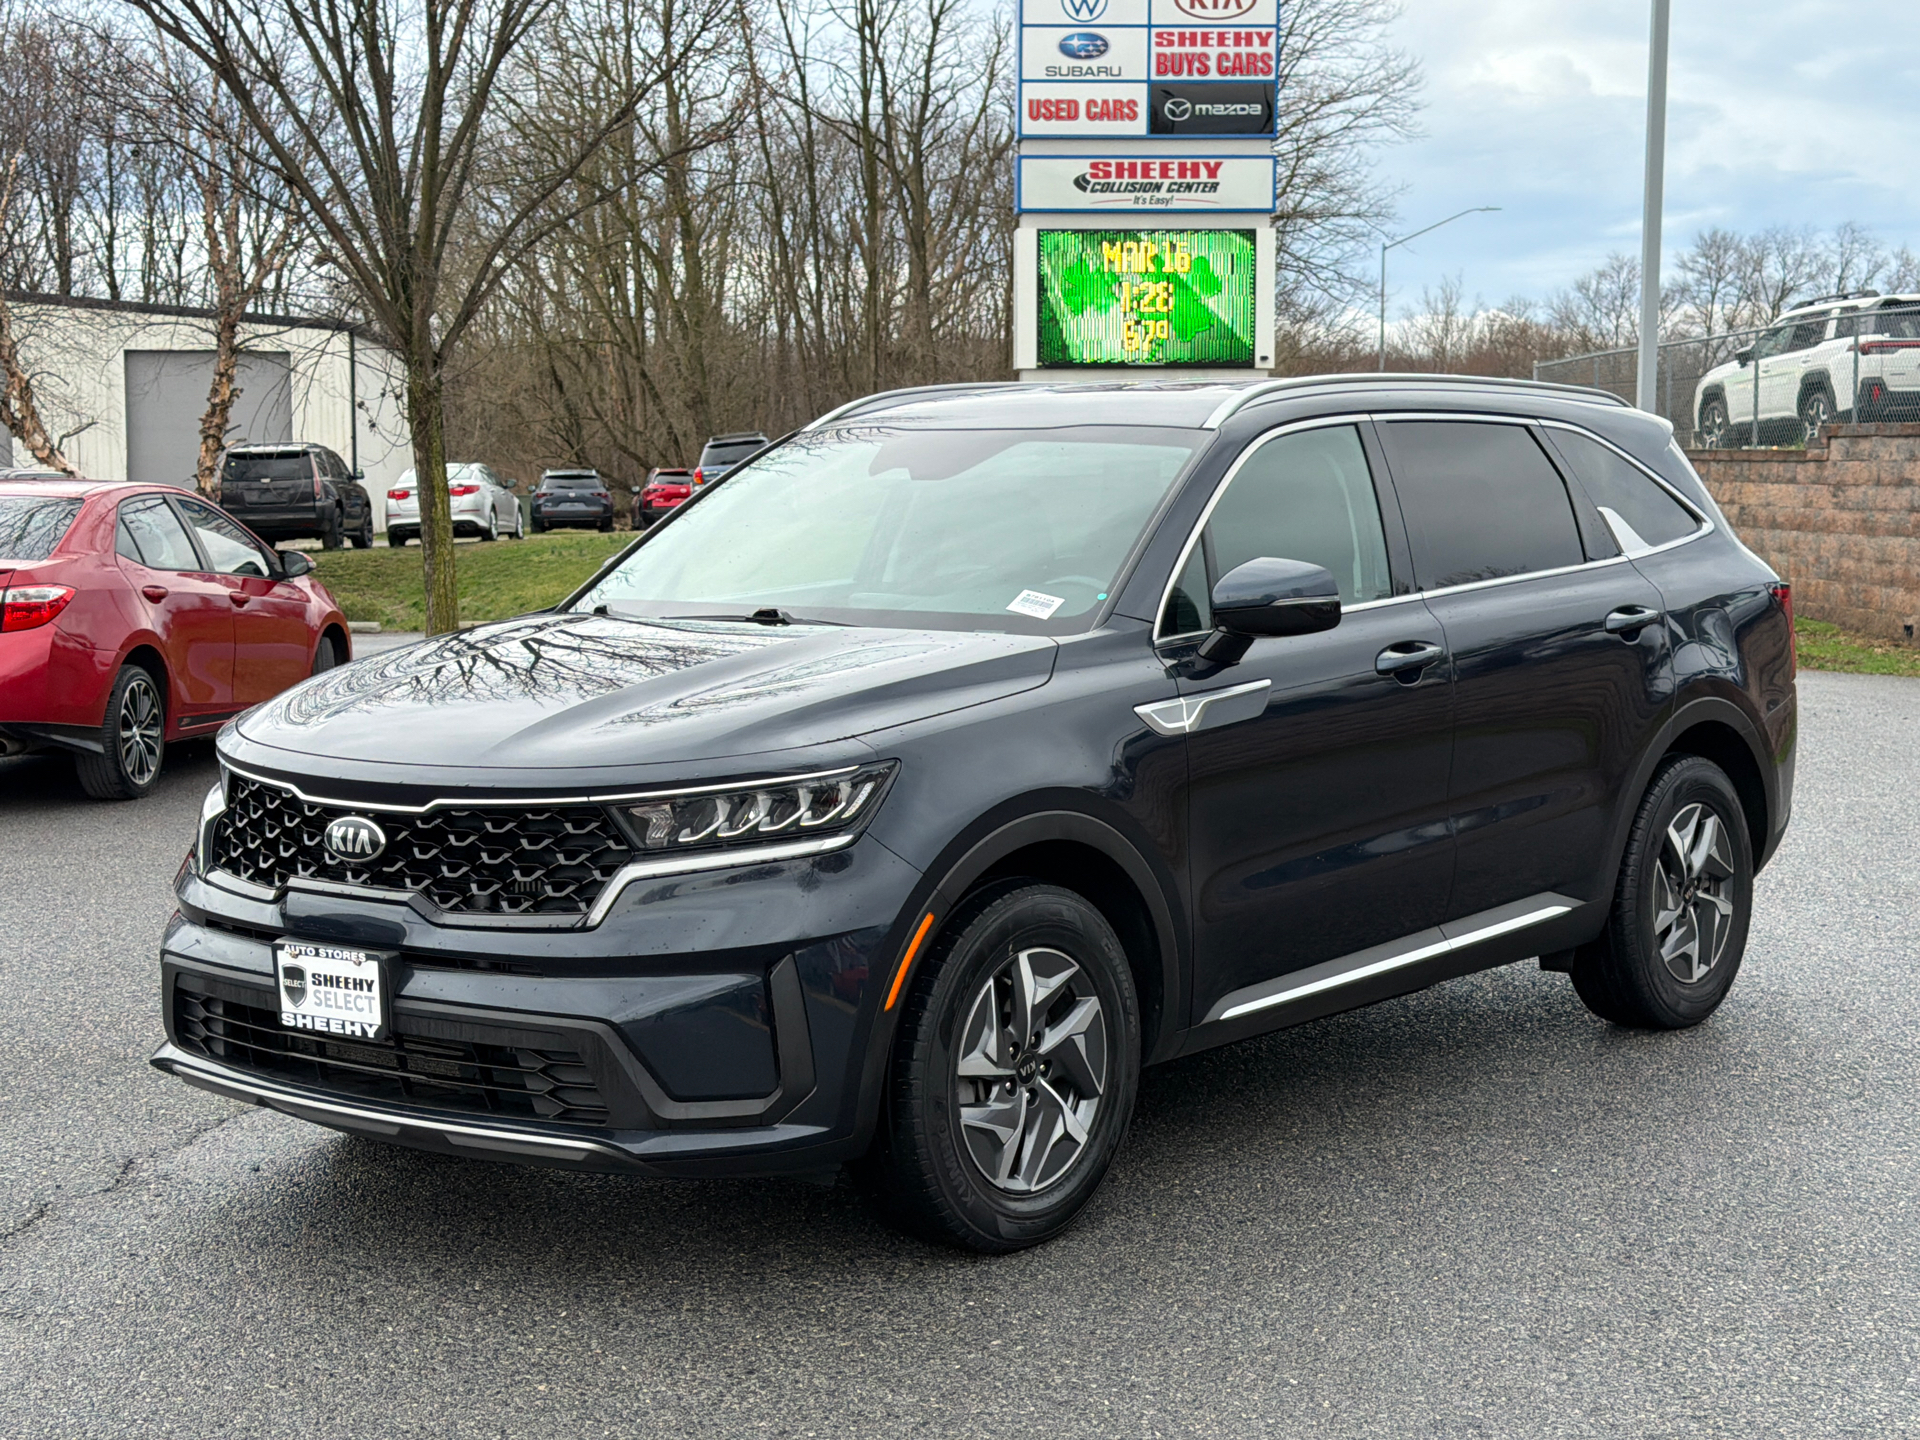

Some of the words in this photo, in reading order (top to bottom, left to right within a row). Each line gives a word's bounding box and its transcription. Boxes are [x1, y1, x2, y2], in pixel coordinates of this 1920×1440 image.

[1154, 31, 1274, 48] SHEEHY
[1045, 65, 1122, 77] SUBARU
[1155, 52, 1210, 77] BUYS
[1216, 52, 1273, 77] CARS
[1028, 98, 1079, 122] USED
[1085, 98, 1138, 122] CARS
[1089, 161, 1224, 180] SHEEHY
[1090, 181, 1165, 194] COLLISION
[1166, 181, 1220, 194] CENTER
[1149, 194, 1174, 207] Easy!
[1102, 241, 1156, 273] MAR
[1162, 241, 1191, 273] 16
[332, 825, 373, 854] KIA
[283, 944, 316, 957] AUTO
[319, 949, 367, 962] STORES
[284, 978, 305, 988] SELECT
[311, 972, 375, 993] SHEEHY
[313, 989, 376, 1014] SELECT
[281, 1012, 380, 1039] SHEEHY
[1019, 1060, 1037, 1077] KIA
